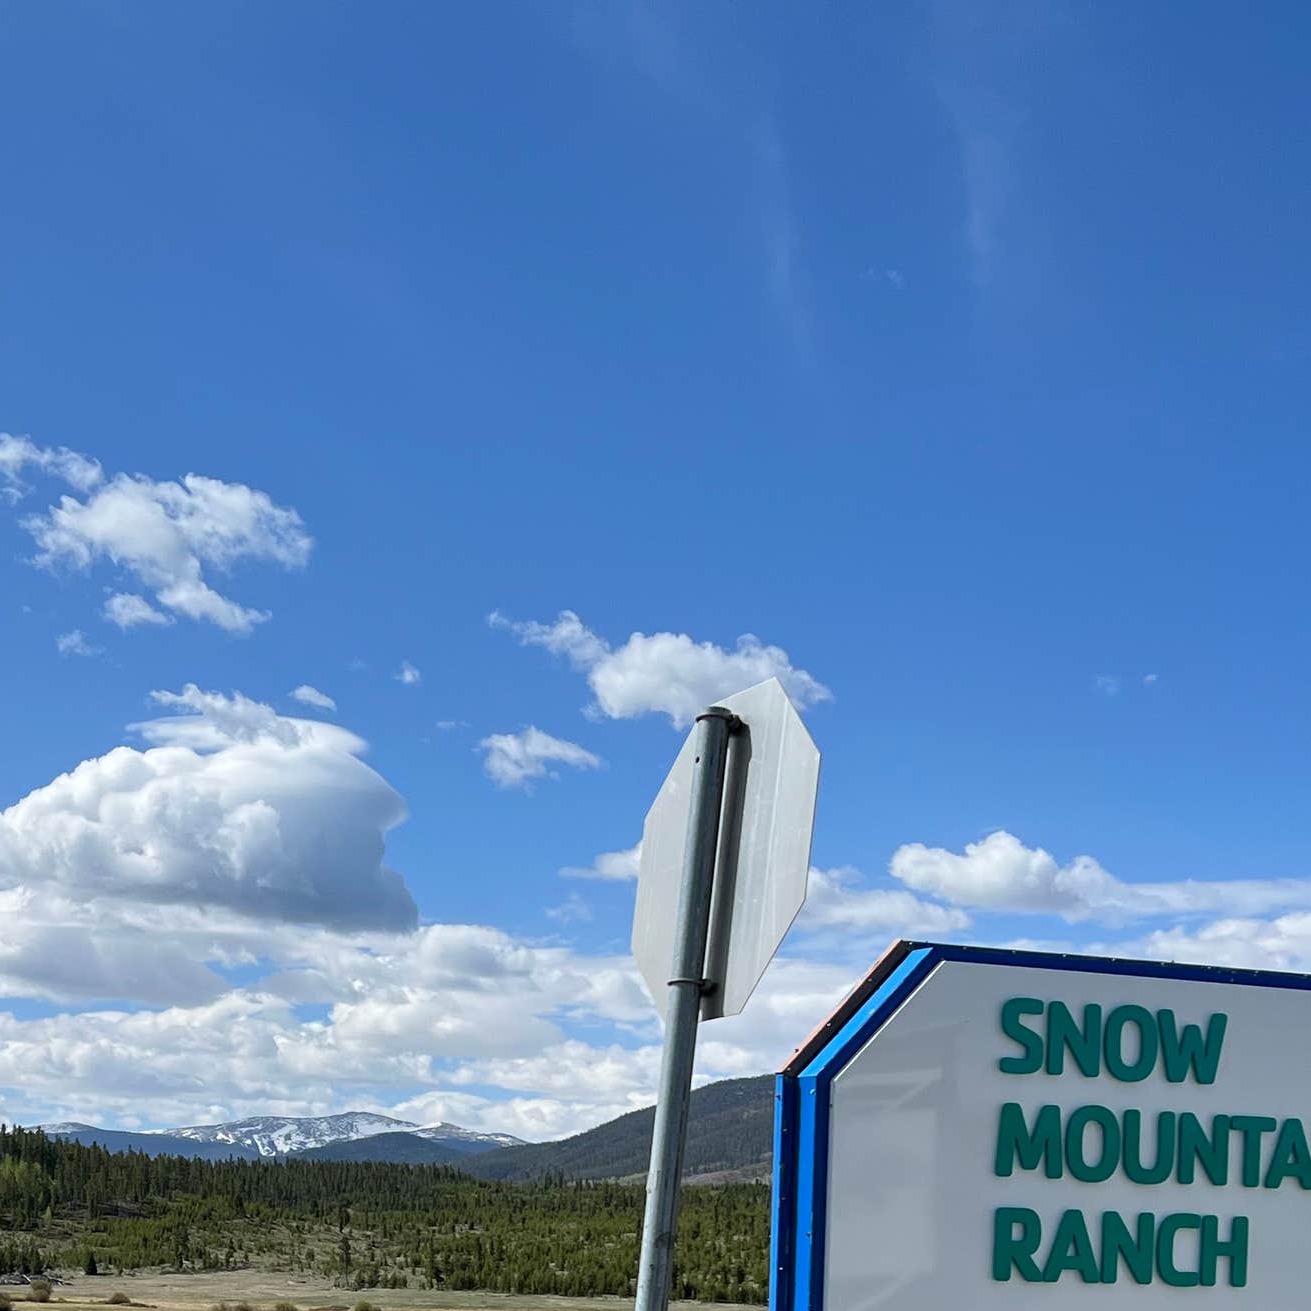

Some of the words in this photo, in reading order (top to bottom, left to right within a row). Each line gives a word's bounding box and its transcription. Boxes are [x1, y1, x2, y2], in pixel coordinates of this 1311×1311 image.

[998, 997, 1228, 1085] SNOW
[993, 1102, 1311, 1191] MOUNTA
[992, 1206, 1249, 1288] RANCH
